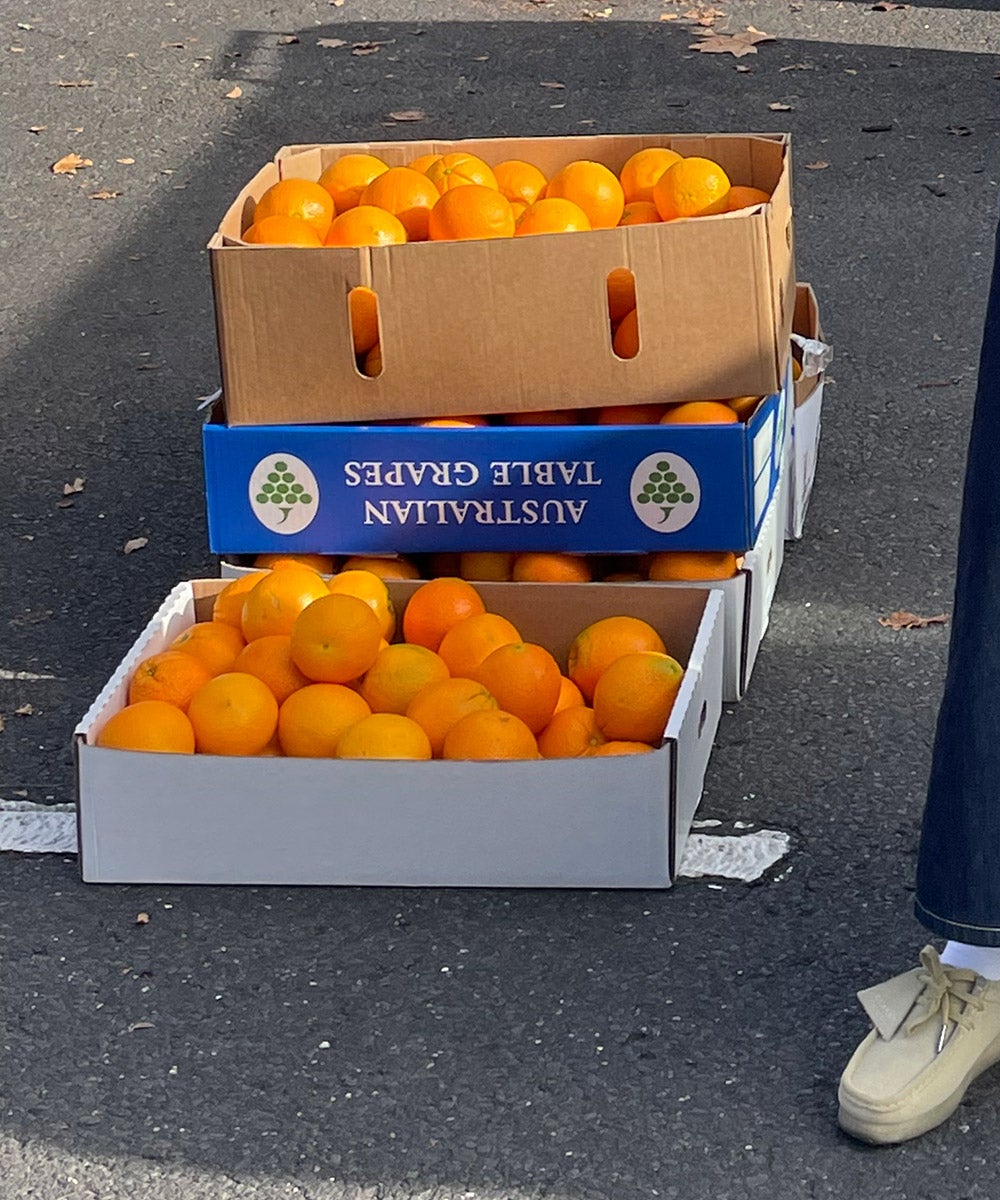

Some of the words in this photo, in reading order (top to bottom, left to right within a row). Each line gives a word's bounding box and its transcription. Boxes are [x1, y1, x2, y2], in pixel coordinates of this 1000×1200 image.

[344, 460, 480, 487] GRAPES
[489, 460, 602, 486] TABLE
[363, 499, 589, 525] AUSTRALIAN
